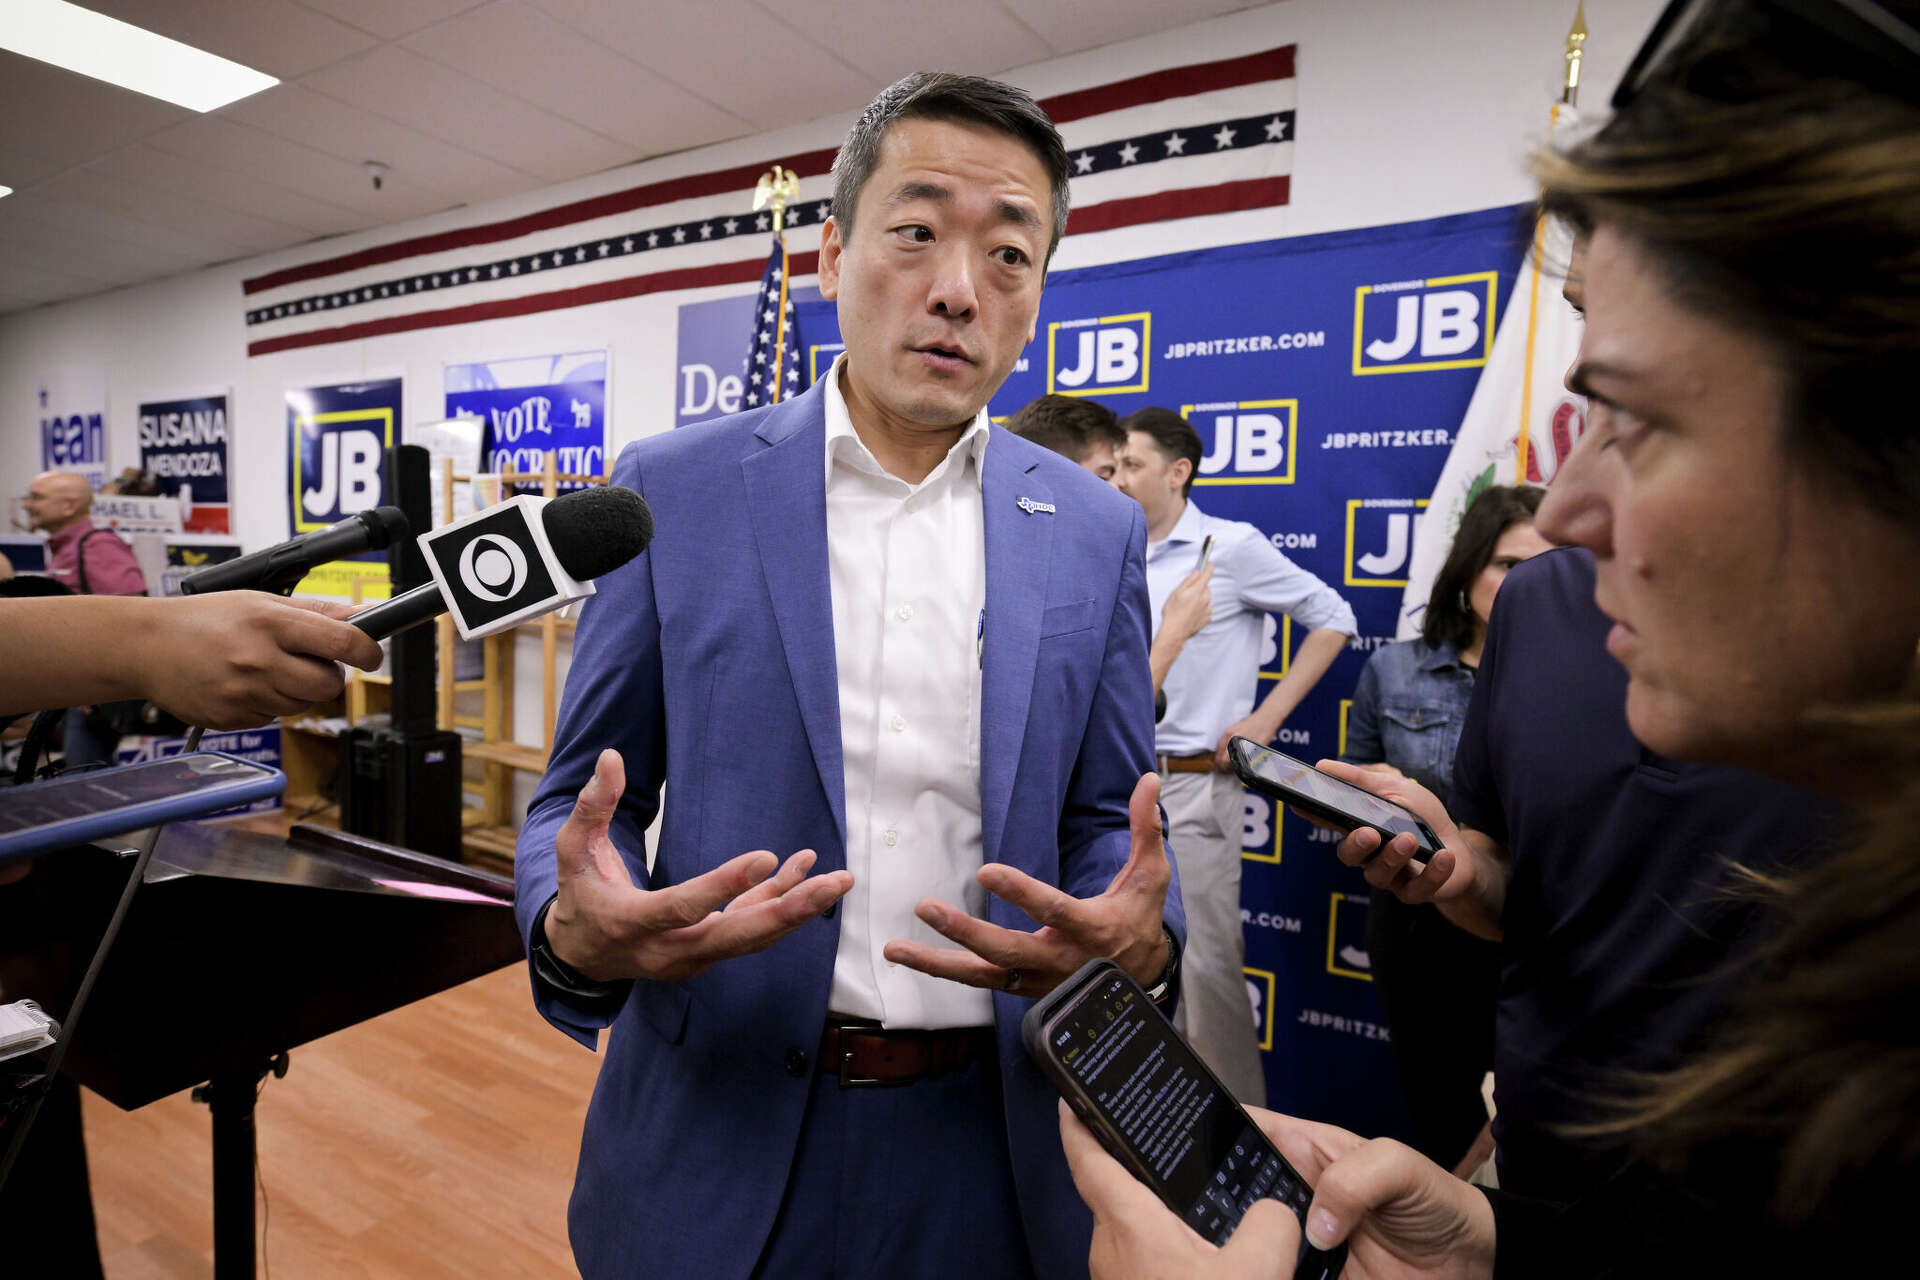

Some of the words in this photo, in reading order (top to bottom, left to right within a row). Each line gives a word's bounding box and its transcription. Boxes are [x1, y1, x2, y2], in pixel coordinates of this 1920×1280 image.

[1164, 331, 1325, 359] JBPRITZKER.COM
[1365, 290, 1480, 361] JB
[1056, 328, 1138, 387] JB
[140, 409, 227, 448] SUSANA
[491, 396, 551, 443] VOTE
[1198, 414, 1284, 474] JB
[147, 452, 223, 478] MENDOZA
[303, 430, 381, 517] JB
